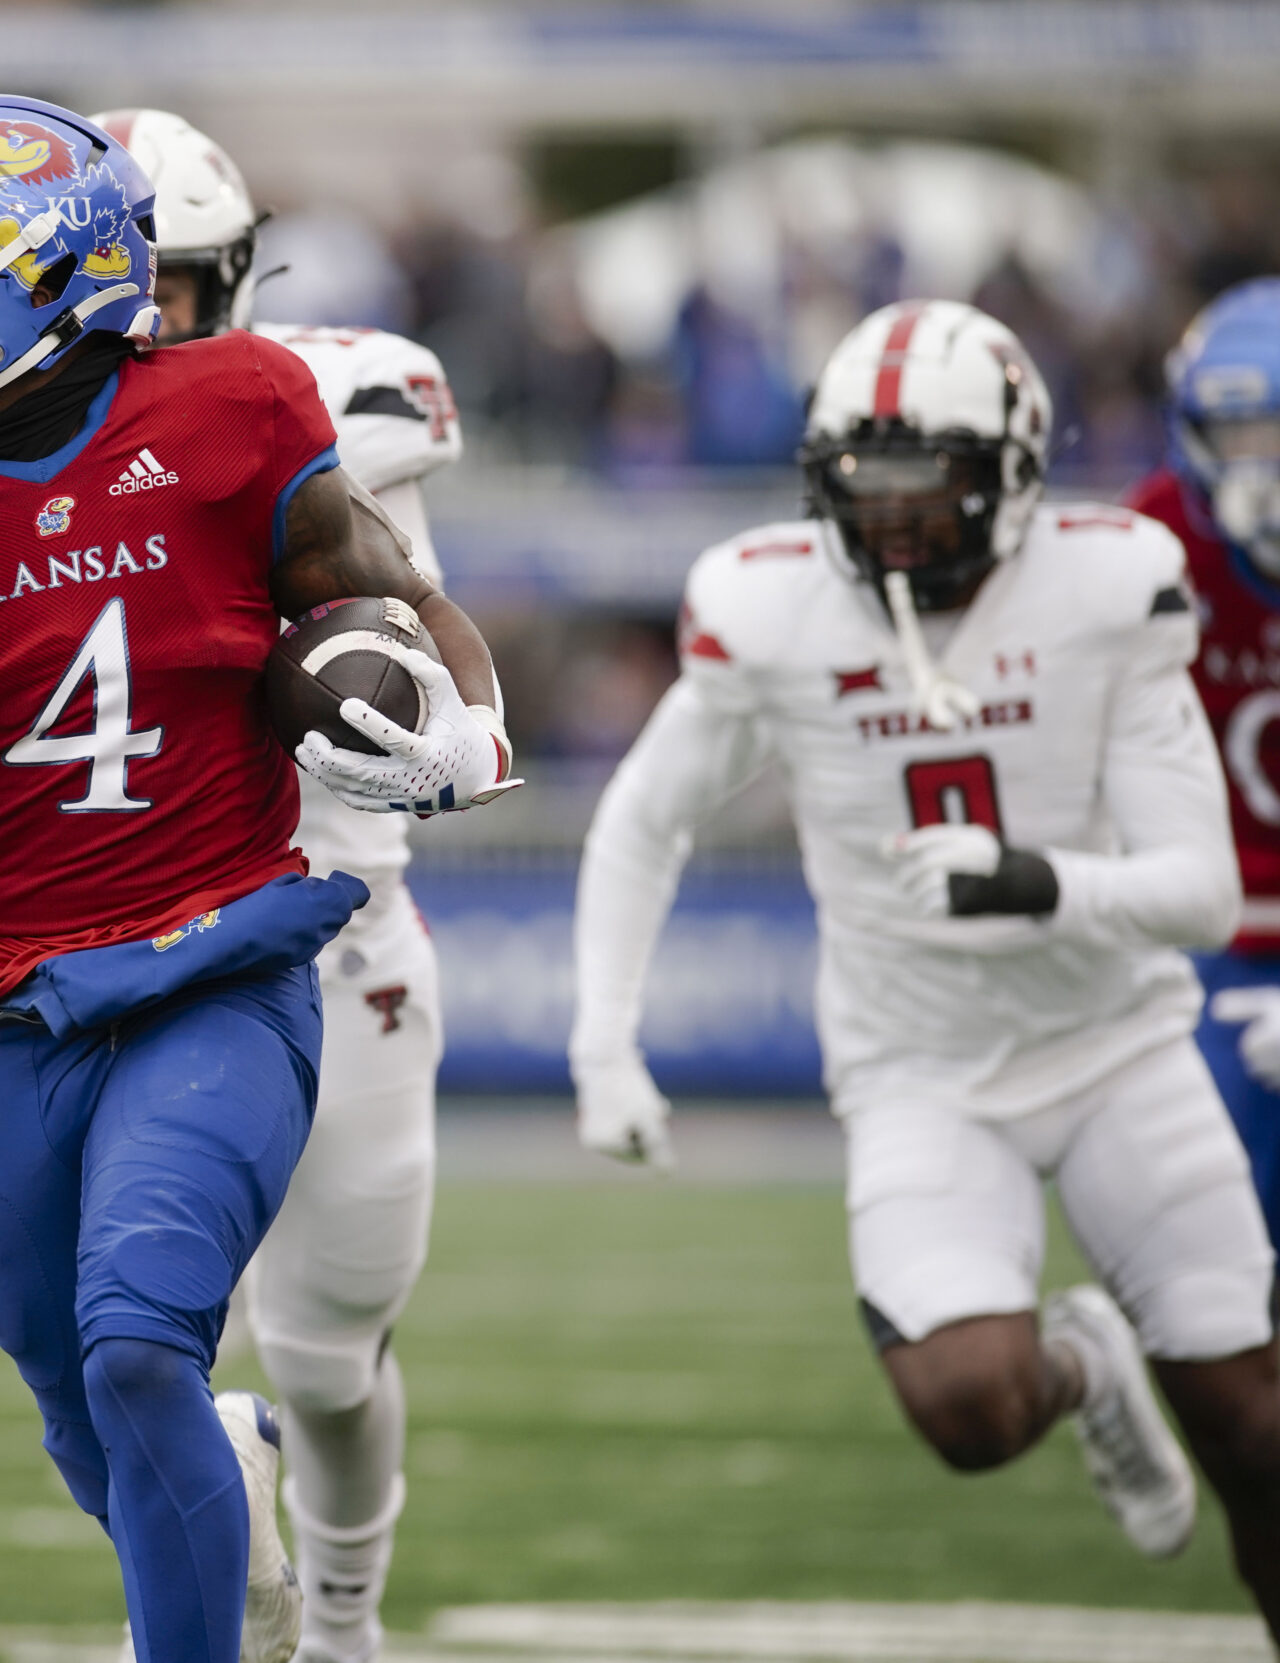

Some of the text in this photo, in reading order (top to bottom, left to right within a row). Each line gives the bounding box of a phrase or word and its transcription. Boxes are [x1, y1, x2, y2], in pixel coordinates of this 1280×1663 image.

[44, 196, 91, 231] KU
[108, 470, 180, 497] adidas
[1, 596, 165, 813] 4
[856, 711, 953, 740] TEXA
